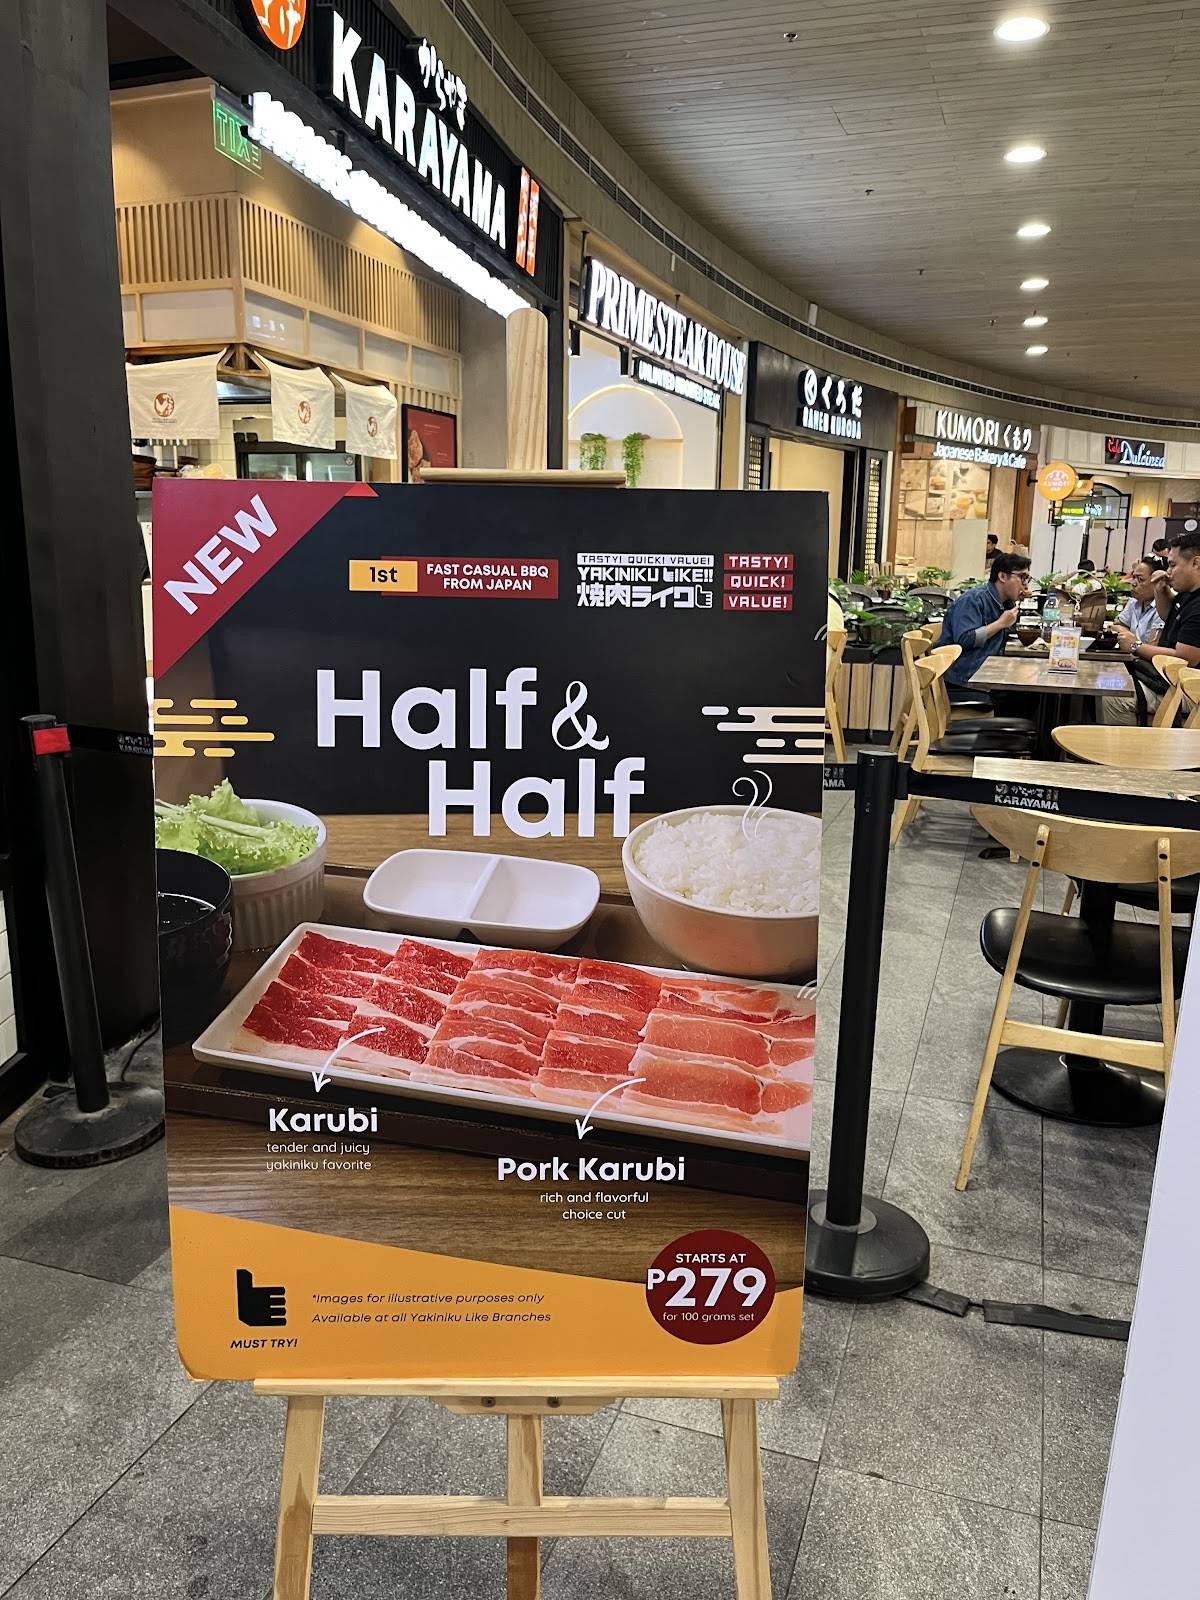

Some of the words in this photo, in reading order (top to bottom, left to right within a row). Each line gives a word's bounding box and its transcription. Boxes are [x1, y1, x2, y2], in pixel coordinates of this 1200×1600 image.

[333, 10, 506, 250] KARAYAMA
[936, 410, 999, 447] KUMORI
[1003, 425, 1032, 451] くもり
[933, 442, 974, 461] Japanese
[163, 494, 277, 615] NEW
[582, 555, 622, 563] TASTY!
[628, 556, 665, 564] QUICK!
[670, 557, 710, 565] VALUE!
[729, 556, 788, 568] TASTY!
[370, 567, 398, 582] 1st
[427, 564, 460, 576] FAST
[463, 564, 517, 577] CASUAL
[521, 565, 549, 578] BBQ
[577, 567, 659, 582] YAKINIKU
[443, 578, 483, 590] FROM
[486, 579, 532, 591] JAPAN
[730, 576, 785, 589] QUICK!
[729, 596, 787, 609] VALUE!
[316, 667, 537, 750] Half
[552, 681, 609, 750] &
[428, 757, 645, 839] Half
[994, 794, 1060, 811] KARAYAMA
[269, 1107, 378, 1133] Karubi
[266, 1142, 308, 1153] tender
[312, 1142, 337, 1153] and
[340, 1142, 370, 1155] juicy
[266, 1159, 318, 1172] yakiniku
[322, 1159, 372, 1170] favorite
[497, 1157, 570, 1181] Pork
[579, 1157, 685, 1181] Karubi
[540, 1192, 563, 1203] rich
[567, 1192, 591, 1203] and
[595, 1192, 649, 1203] flavorful
[562, 1209, 603, 1220] choice
[606, 1210, 626, 1220] cut
[675, 1253, 726, 1263] STARTS
[729, 1254, 747, 1263] AT
[367, 1293, 385, 1303] for
[387, 1293, 453, 1303] illustrative
[456, 1294, 514, 1305] purposes
[517, 1293, 545, 1305] only
[312, 1313, 371, 1323] Available
[374, 1314, 389, 1322] at
[391, 1313, 407, 1322] all
[411, 1313, 462, 1322] Yakiniku
[465, 1313, 489, 1322] Like
[492, 1312, 551, 1322] Branches
[663, 1312, 678, 1321] for
[682, 1312, 699, 1321] 100
[701, 1314, 736, 1323] grams
[738, 1312, 754, 1321] set
[230, 1340, 267, 1349] MUST
[270, 1338, 298, 1348] TRY!
